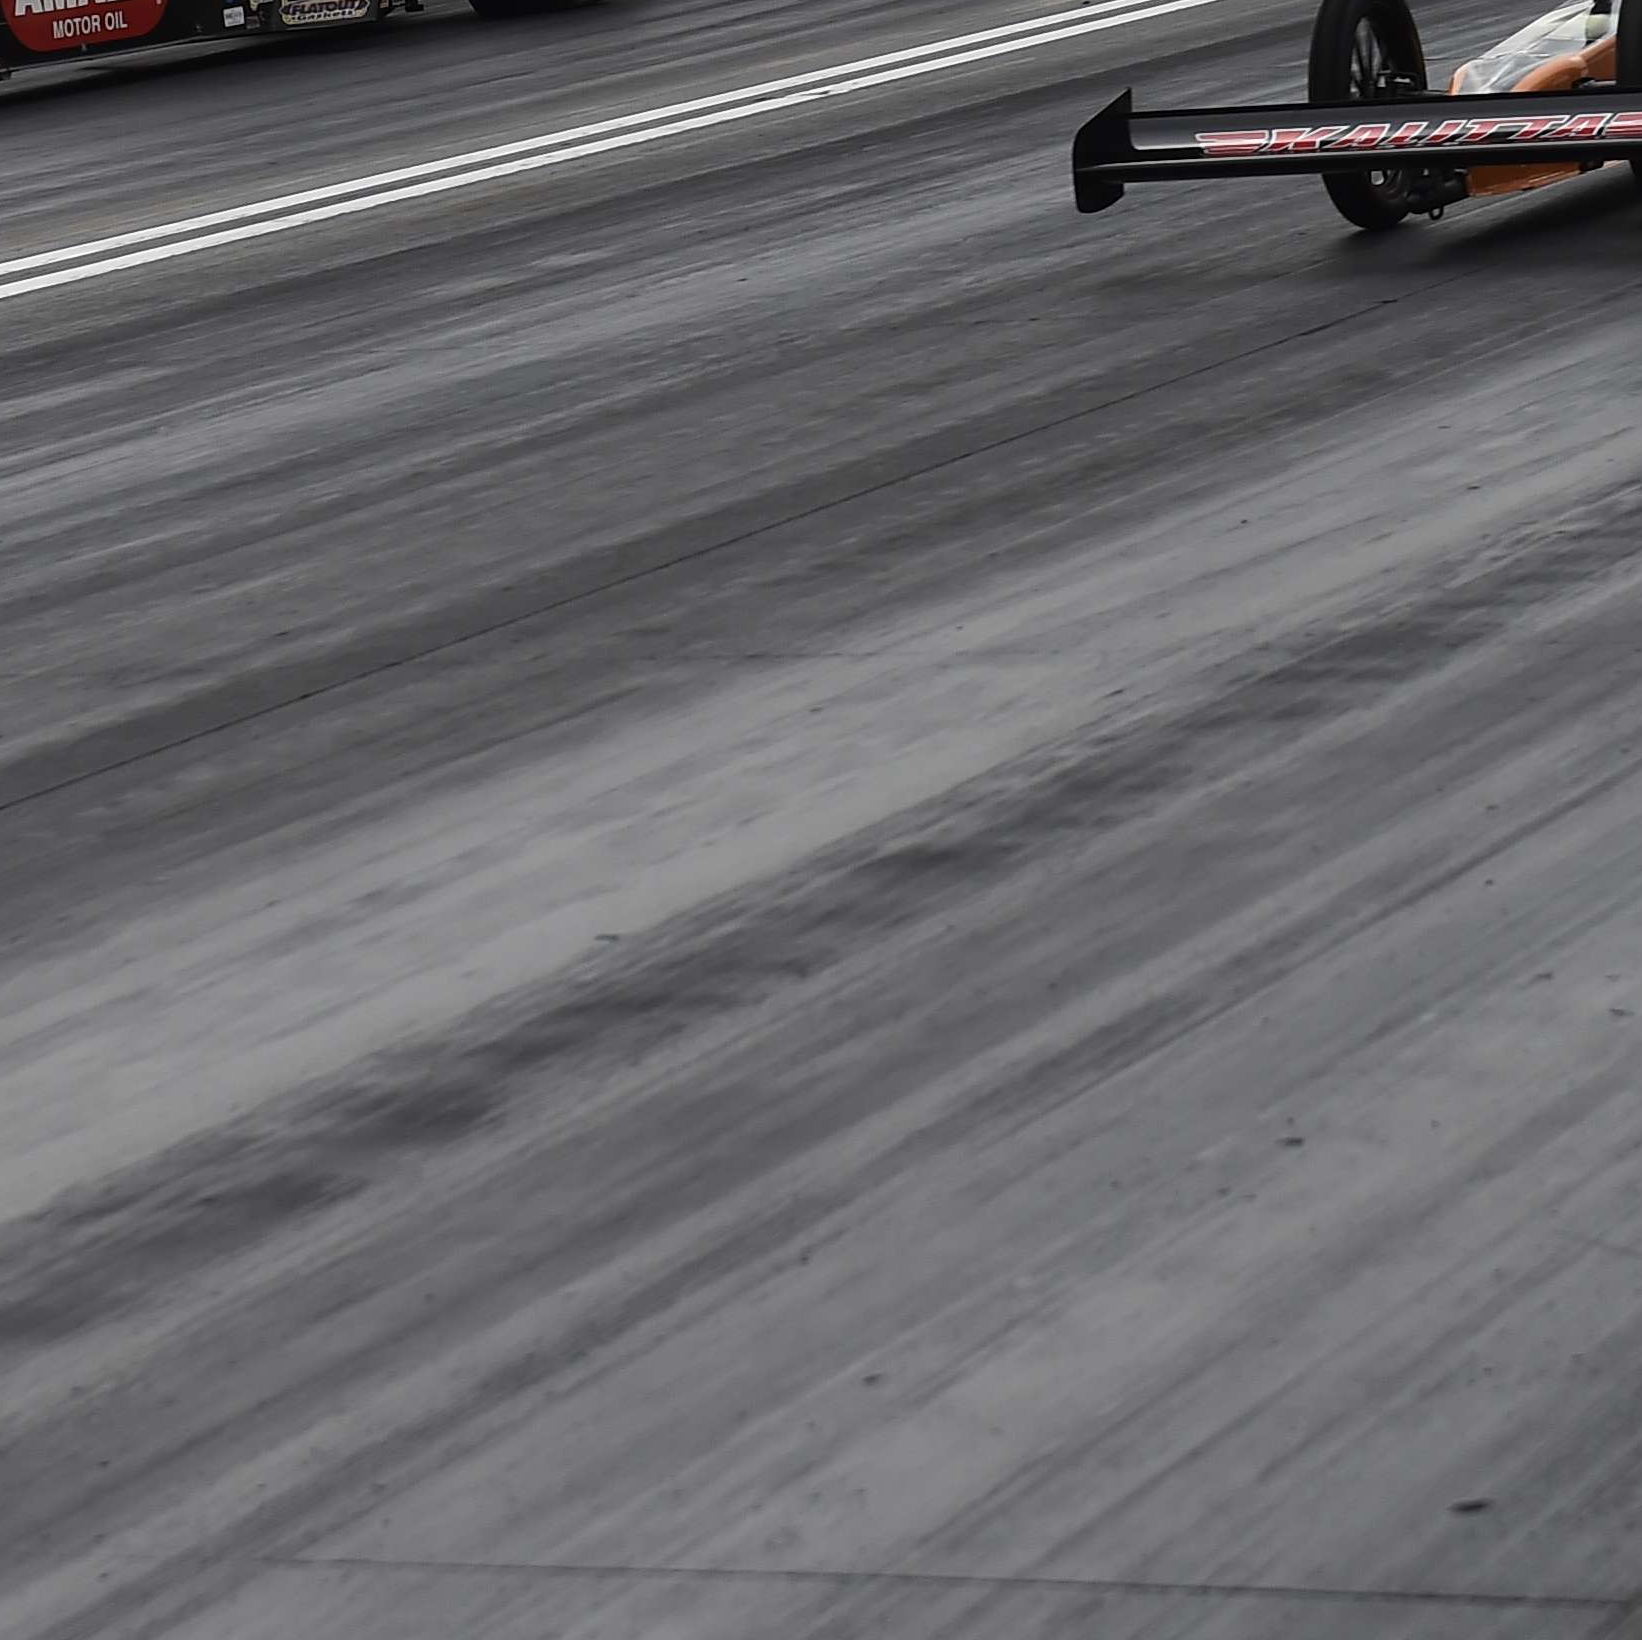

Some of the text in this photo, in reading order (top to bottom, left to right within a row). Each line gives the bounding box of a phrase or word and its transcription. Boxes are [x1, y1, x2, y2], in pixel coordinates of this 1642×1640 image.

[53, 10, 128, 39] MOTOR OIL
[1261, 112, 1613, 153] KALITTA
